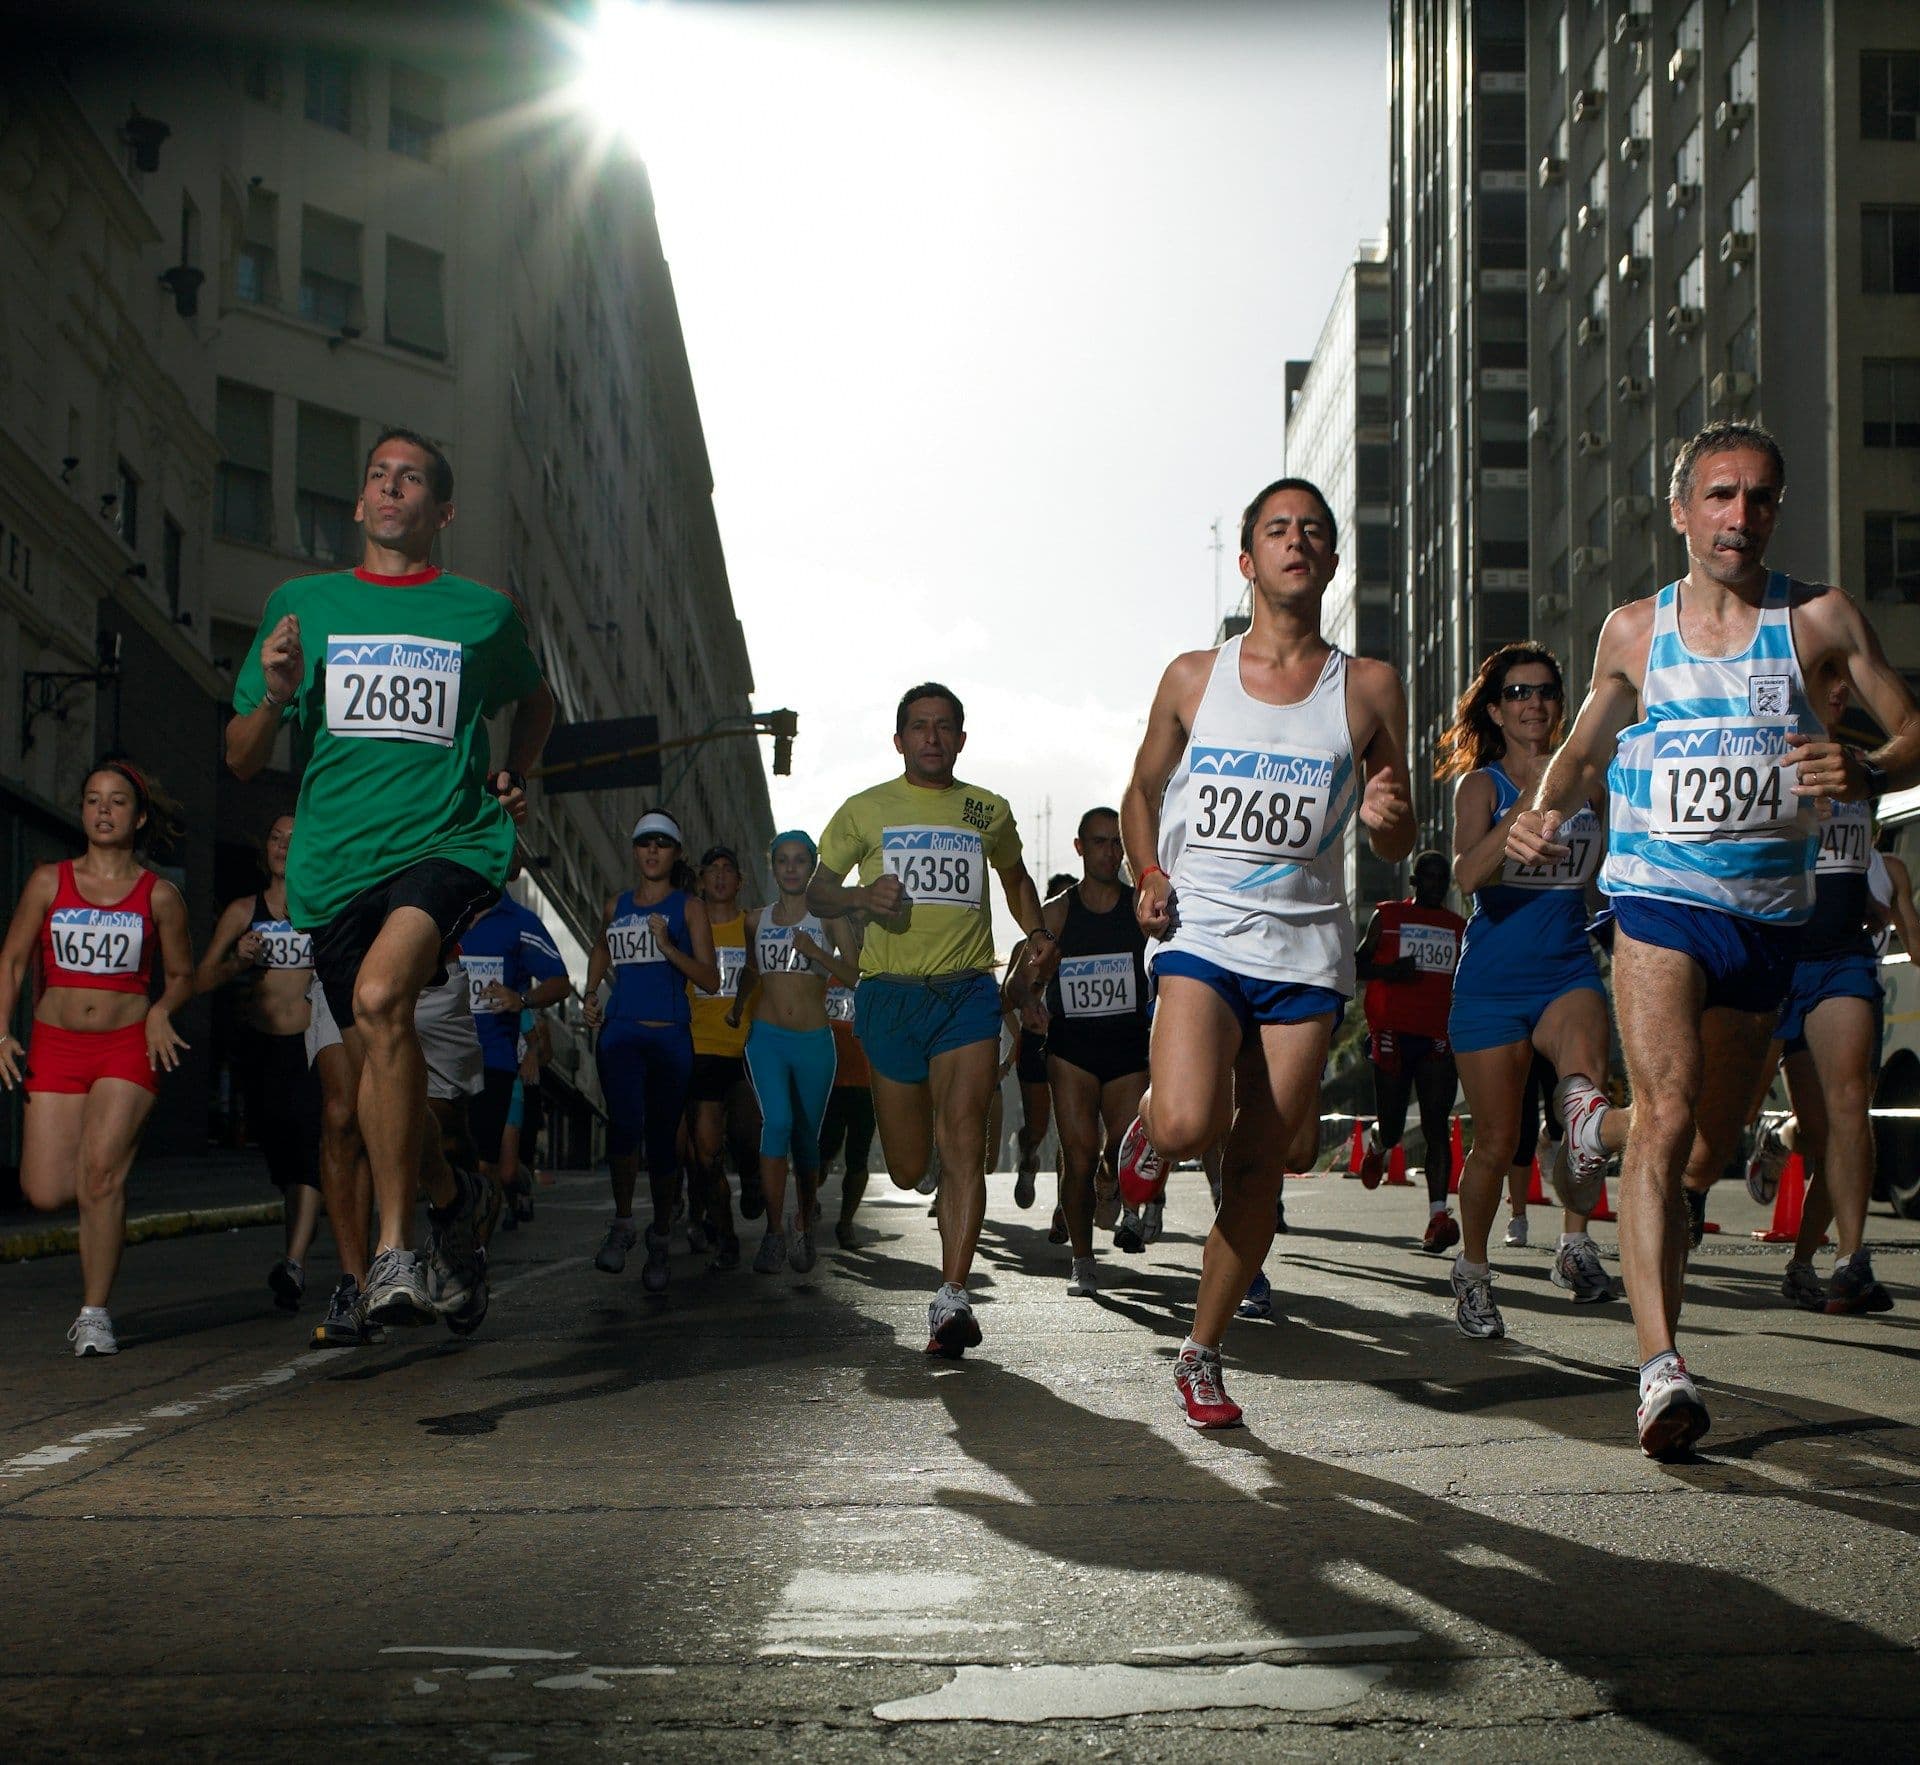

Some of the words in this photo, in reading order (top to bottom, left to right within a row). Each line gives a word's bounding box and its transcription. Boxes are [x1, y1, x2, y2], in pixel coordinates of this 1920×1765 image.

[390, 644, 461, 674] RunStyle
[343, 673, 446, 728] 26831
[1717, 725, 1793, 756] RunStyl
[1253, 753, 1333, 789] RunStyle
[964, 797, 983, 814] BA
[1668, 766, 1782, 823] 12394
[962, 812, 990, 830] 2007
[1196, 784, 1316, 849] 32685
[930, 832, 982, 856] RunStyle
[891, 855, 970, 894] 16358
[89, 909, 143, 929] RunStyle
[52, 930, 130, 968] 16542
[608, 931, 655, 960] 21541
[1407, 941, 1453, 967] 24369
[1068, 978, 1128, 1009] 13594
